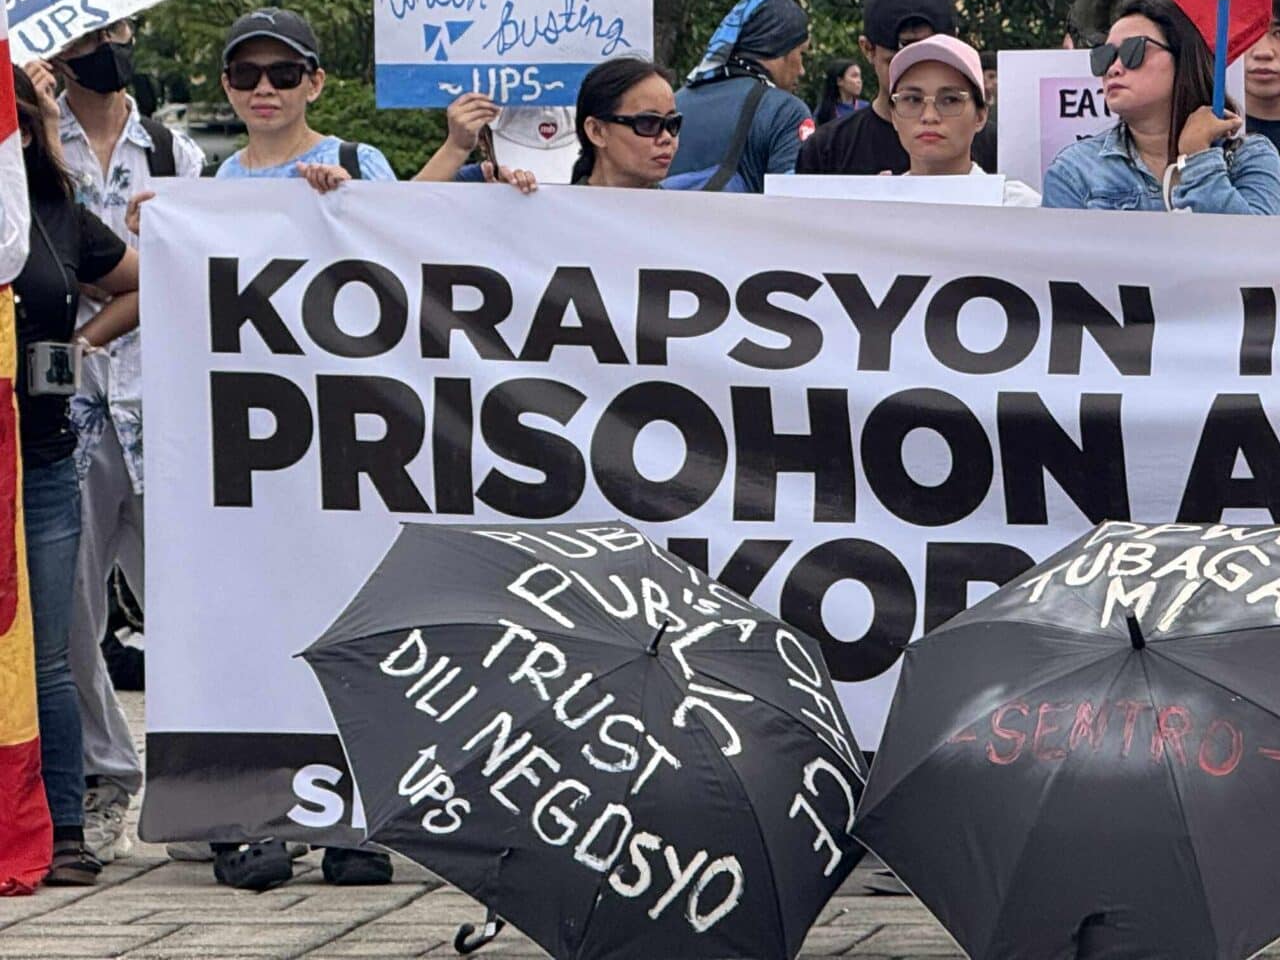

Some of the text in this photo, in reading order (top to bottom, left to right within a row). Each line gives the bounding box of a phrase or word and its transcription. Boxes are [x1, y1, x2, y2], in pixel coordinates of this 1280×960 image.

[207, 256, 1155, 377] KORAPSYON
[209, 370, 1131, 527] PRISOHON
[507, 562, 754, 757] PUBLIC
[1101, 576, 1200, 632] MI
[380, 629, 478, 723] DILI
[482, 618, 682, 794] TRUST
